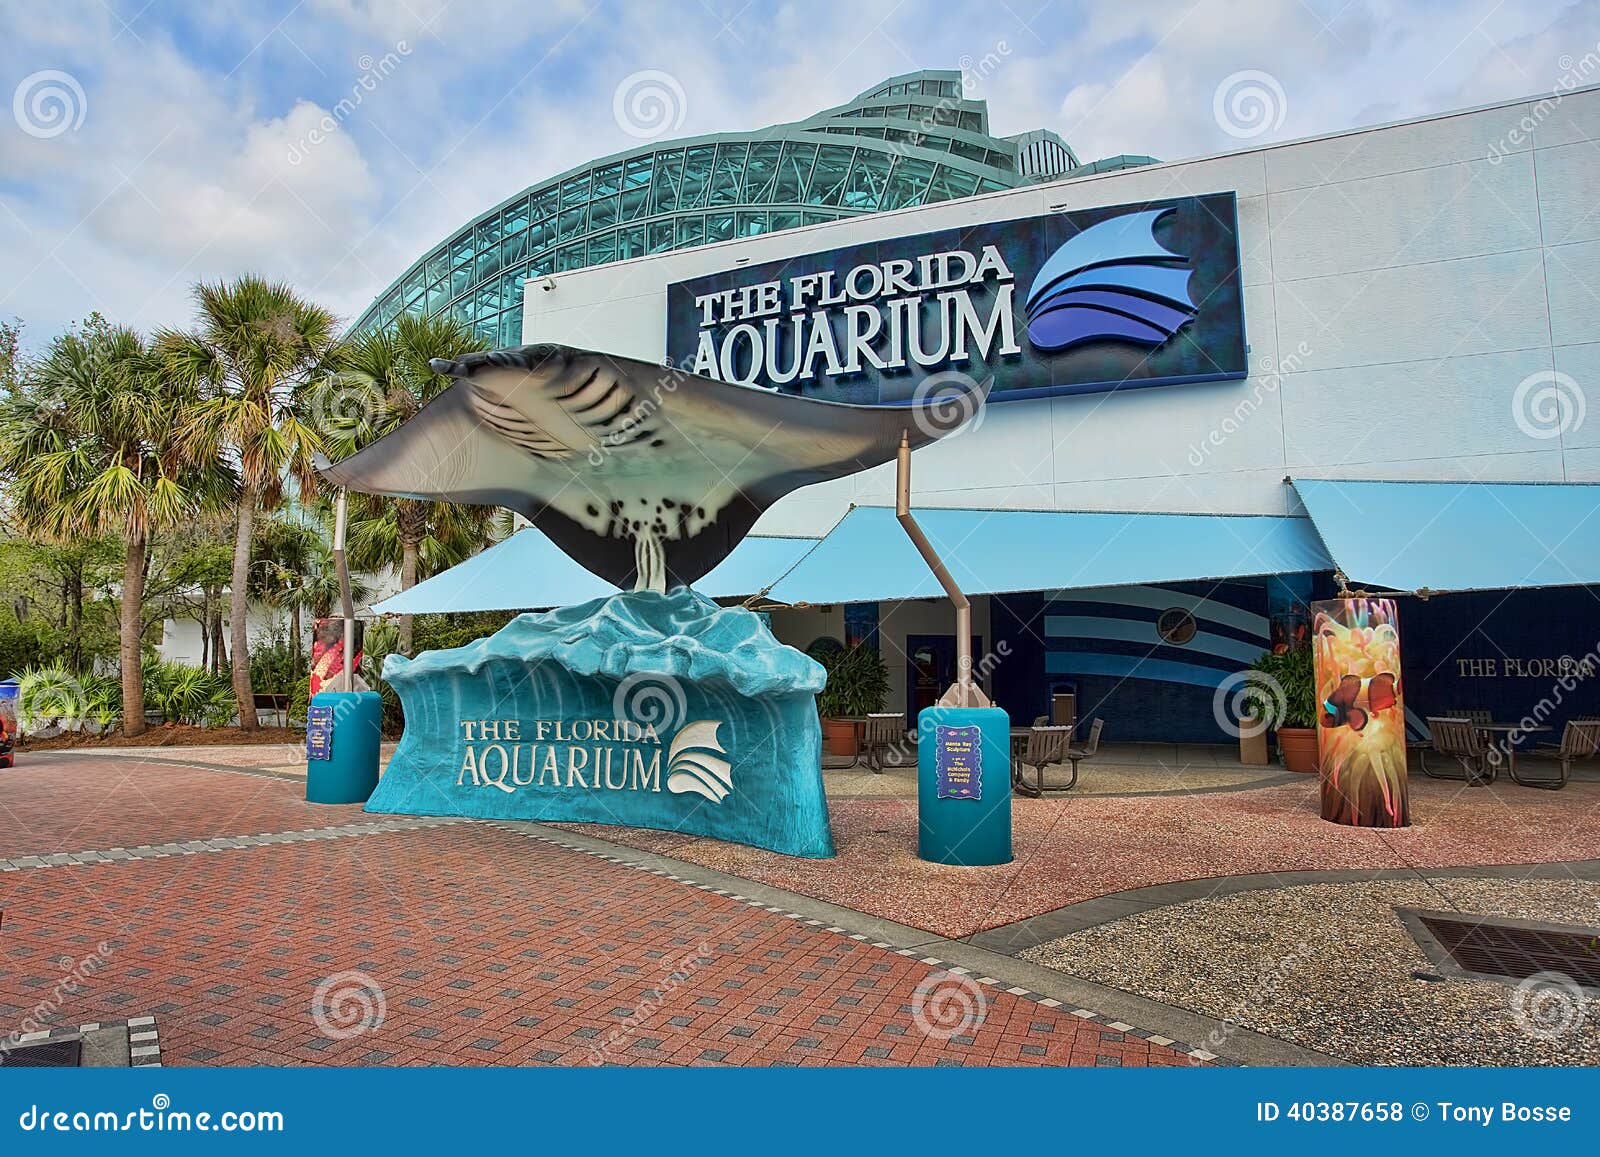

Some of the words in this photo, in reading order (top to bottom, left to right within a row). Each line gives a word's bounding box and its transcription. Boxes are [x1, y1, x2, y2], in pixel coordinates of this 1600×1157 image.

[696, 281, 781, 328] THE
[790, 245, 1014, 311] FLORIDA
[693, 283, 1021, 393] AQUARIUM
[1456, 658, 1497, 677] THE
[1503, 658, 1595, 677] FLORIDA
[460, 719, 520, 741] THE
[535, 719, 662, 745] FLORIDA
[456, 744, 662, 793] AQUARIUM
